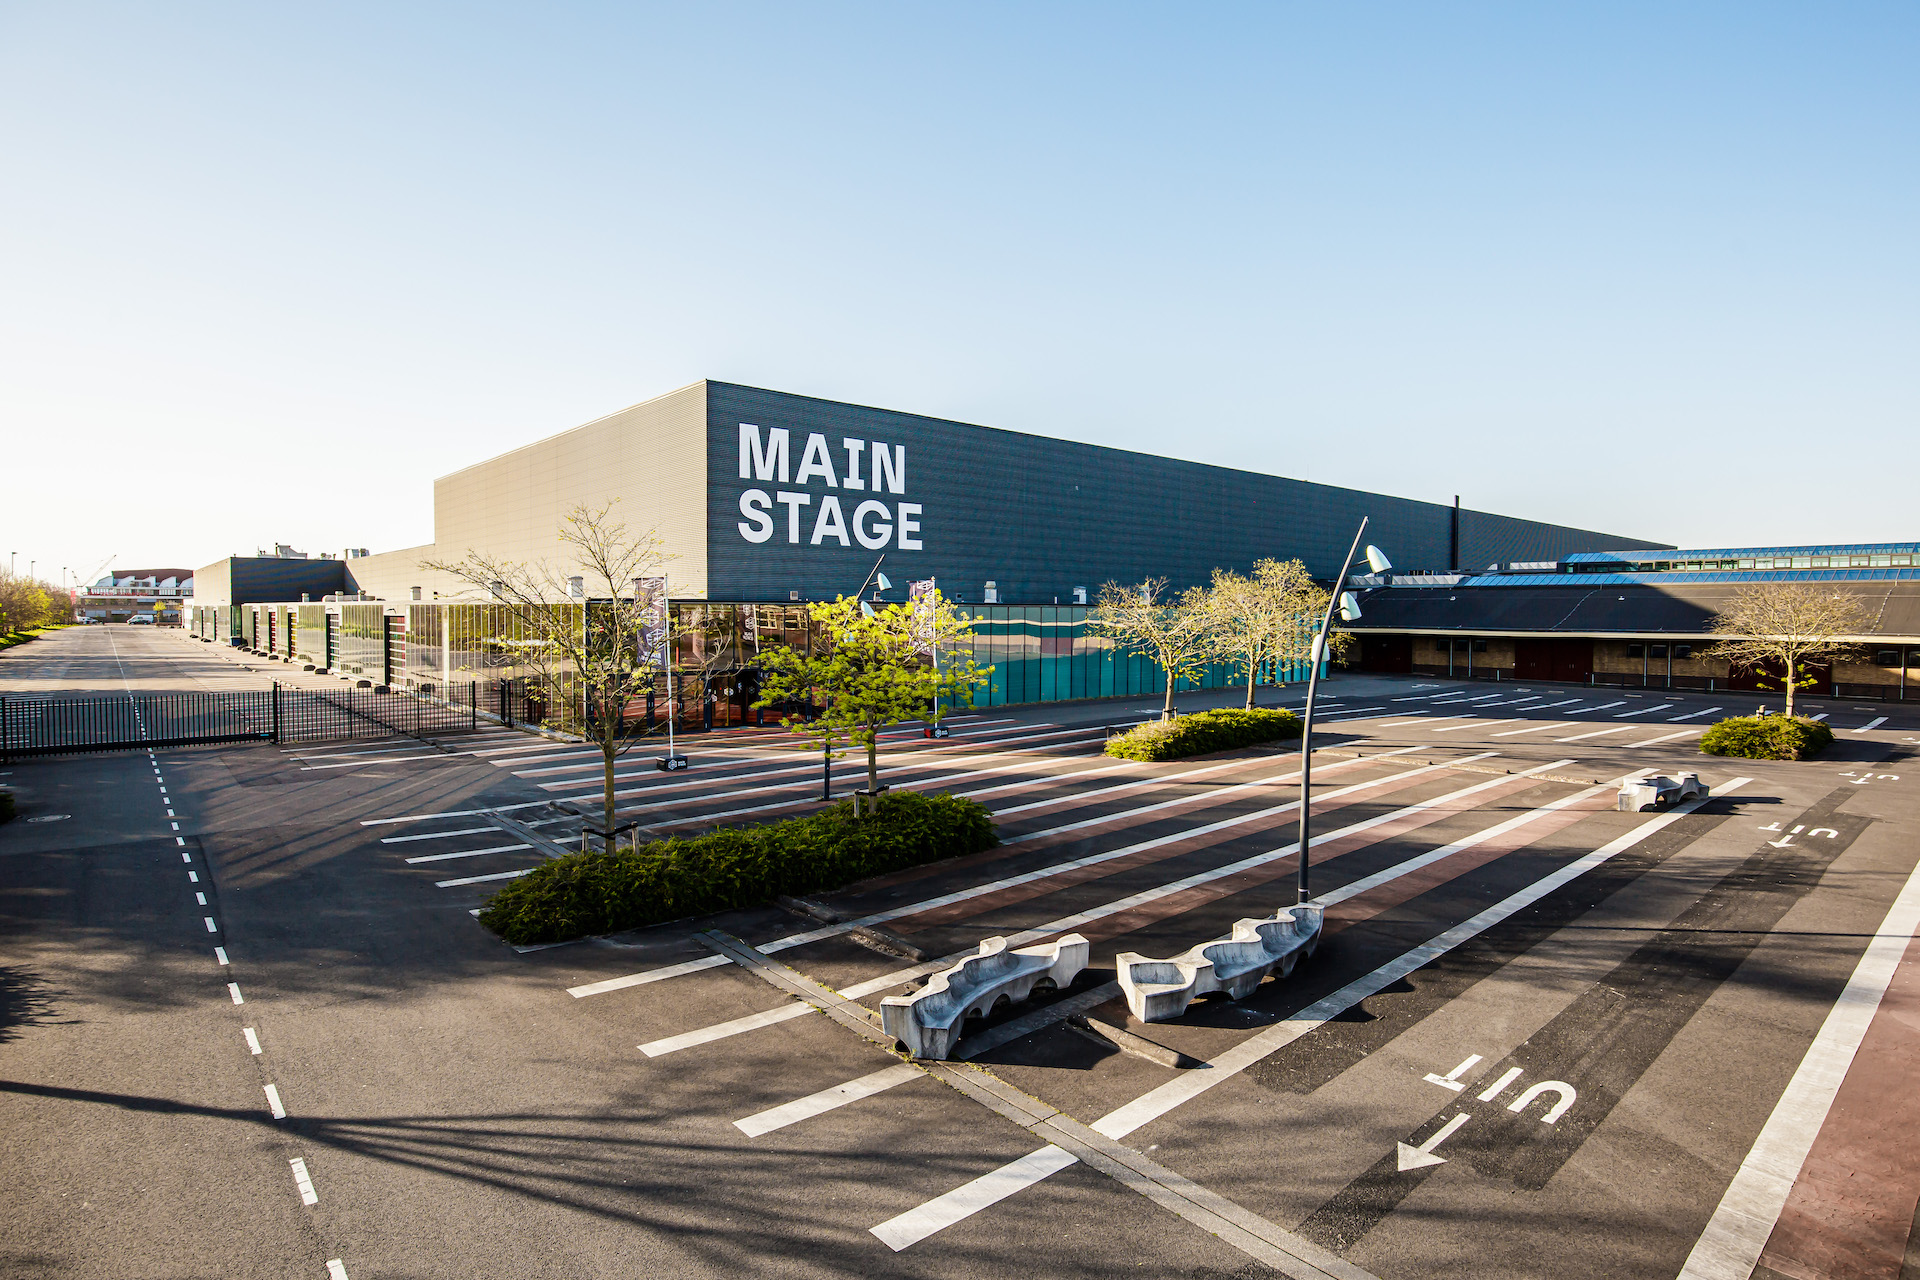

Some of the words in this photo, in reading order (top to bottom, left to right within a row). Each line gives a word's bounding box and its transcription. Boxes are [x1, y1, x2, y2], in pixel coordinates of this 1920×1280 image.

[738, 422, 906, 495] MAIN
[737, 488, 923, 551] STAGE
[1838, 771, 1900, 781] UIT
[1757, 821, 1839, 839] UIT
[1421, 1053, 1577, 1125] UIT
